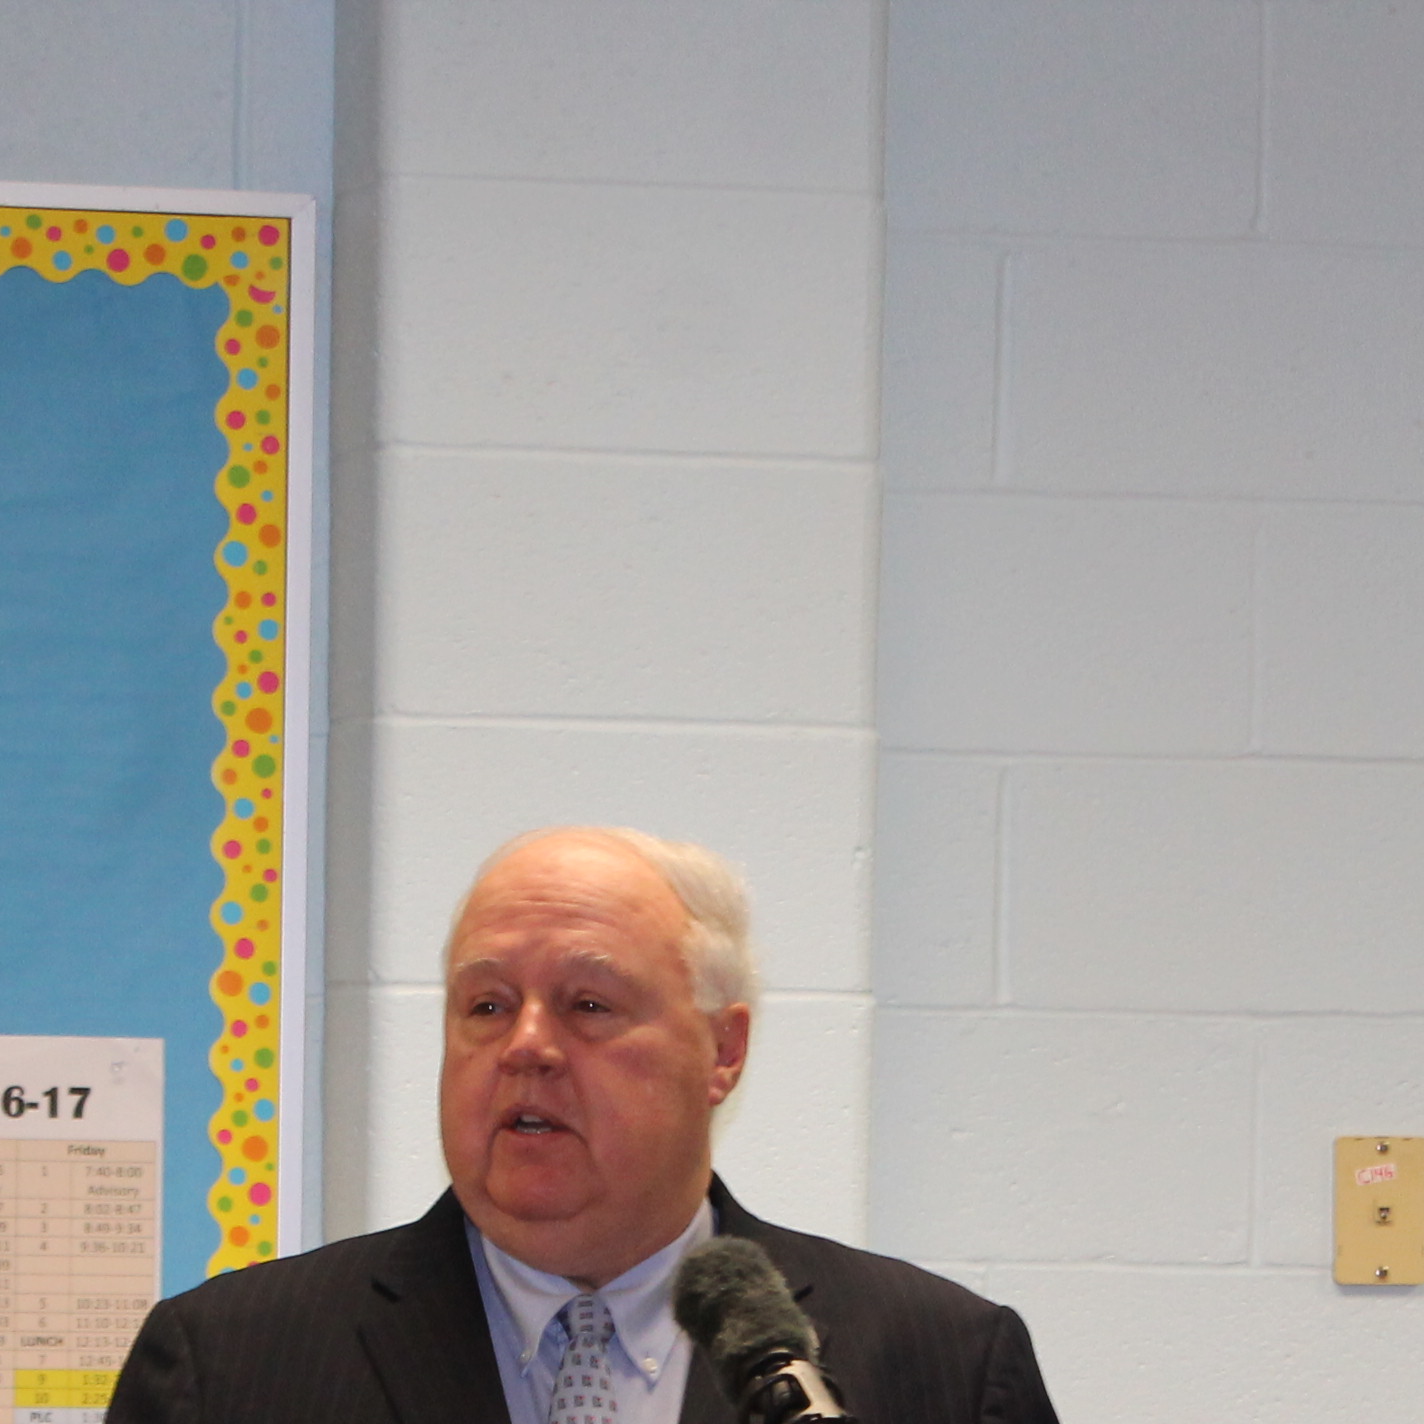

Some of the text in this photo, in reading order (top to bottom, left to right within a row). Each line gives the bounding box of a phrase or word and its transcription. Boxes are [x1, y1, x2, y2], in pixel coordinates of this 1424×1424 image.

[67, 1145, 105, 1158] Friday
[87, 1186, 140, 1199] Advisory
[20, 1336, 63, 1348] LUNCH
[30, 1411, 52, 1423] PLC
